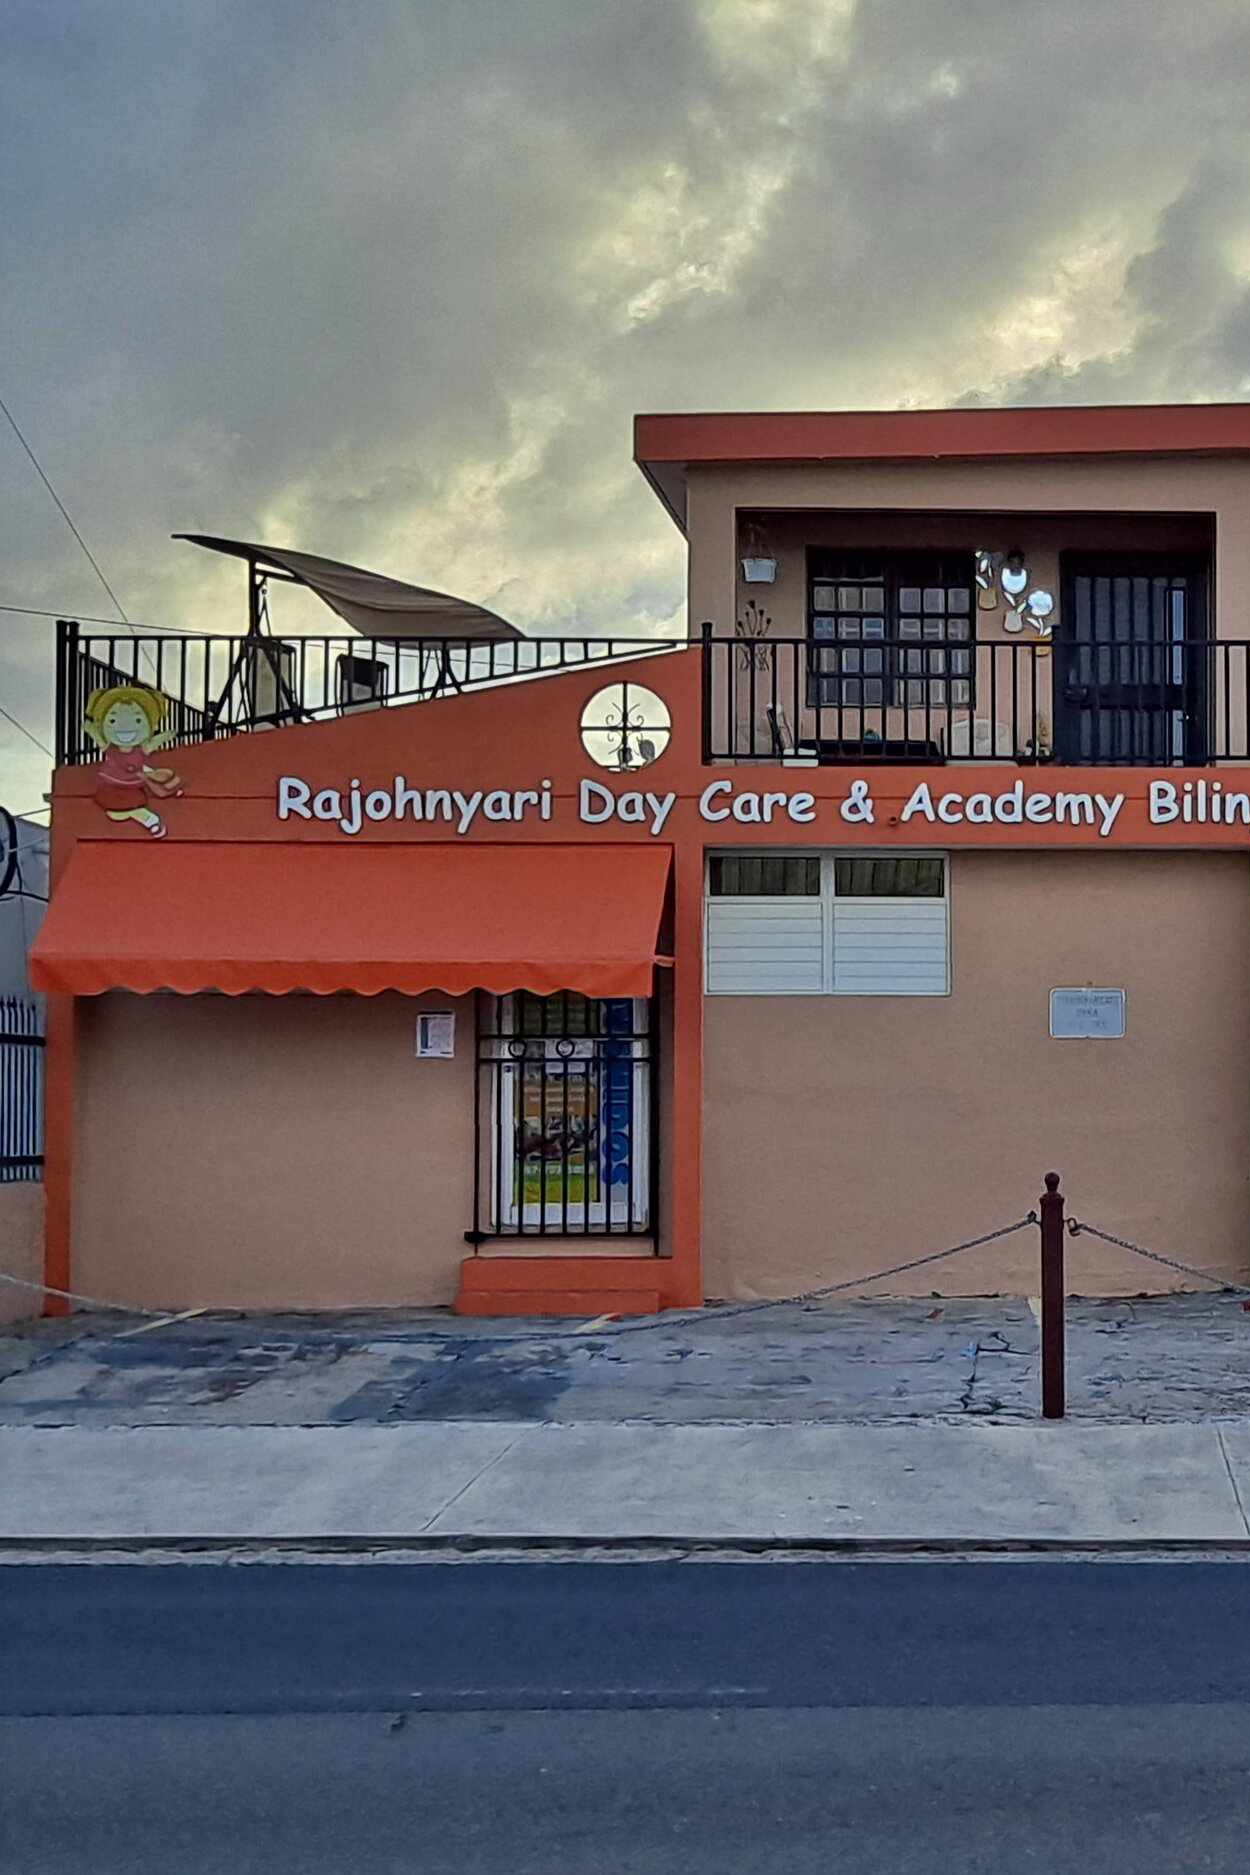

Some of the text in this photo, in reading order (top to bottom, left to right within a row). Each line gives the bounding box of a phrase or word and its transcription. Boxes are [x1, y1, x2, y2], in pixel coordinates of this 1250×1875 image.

[278, 775, 552, 835] Rajohnyari
[579, 777, 677, 836] Day
[698, 779, 817, 824] Care
[839, 778, 876, 825] &
[899, 778, 1126, 837] Academy
